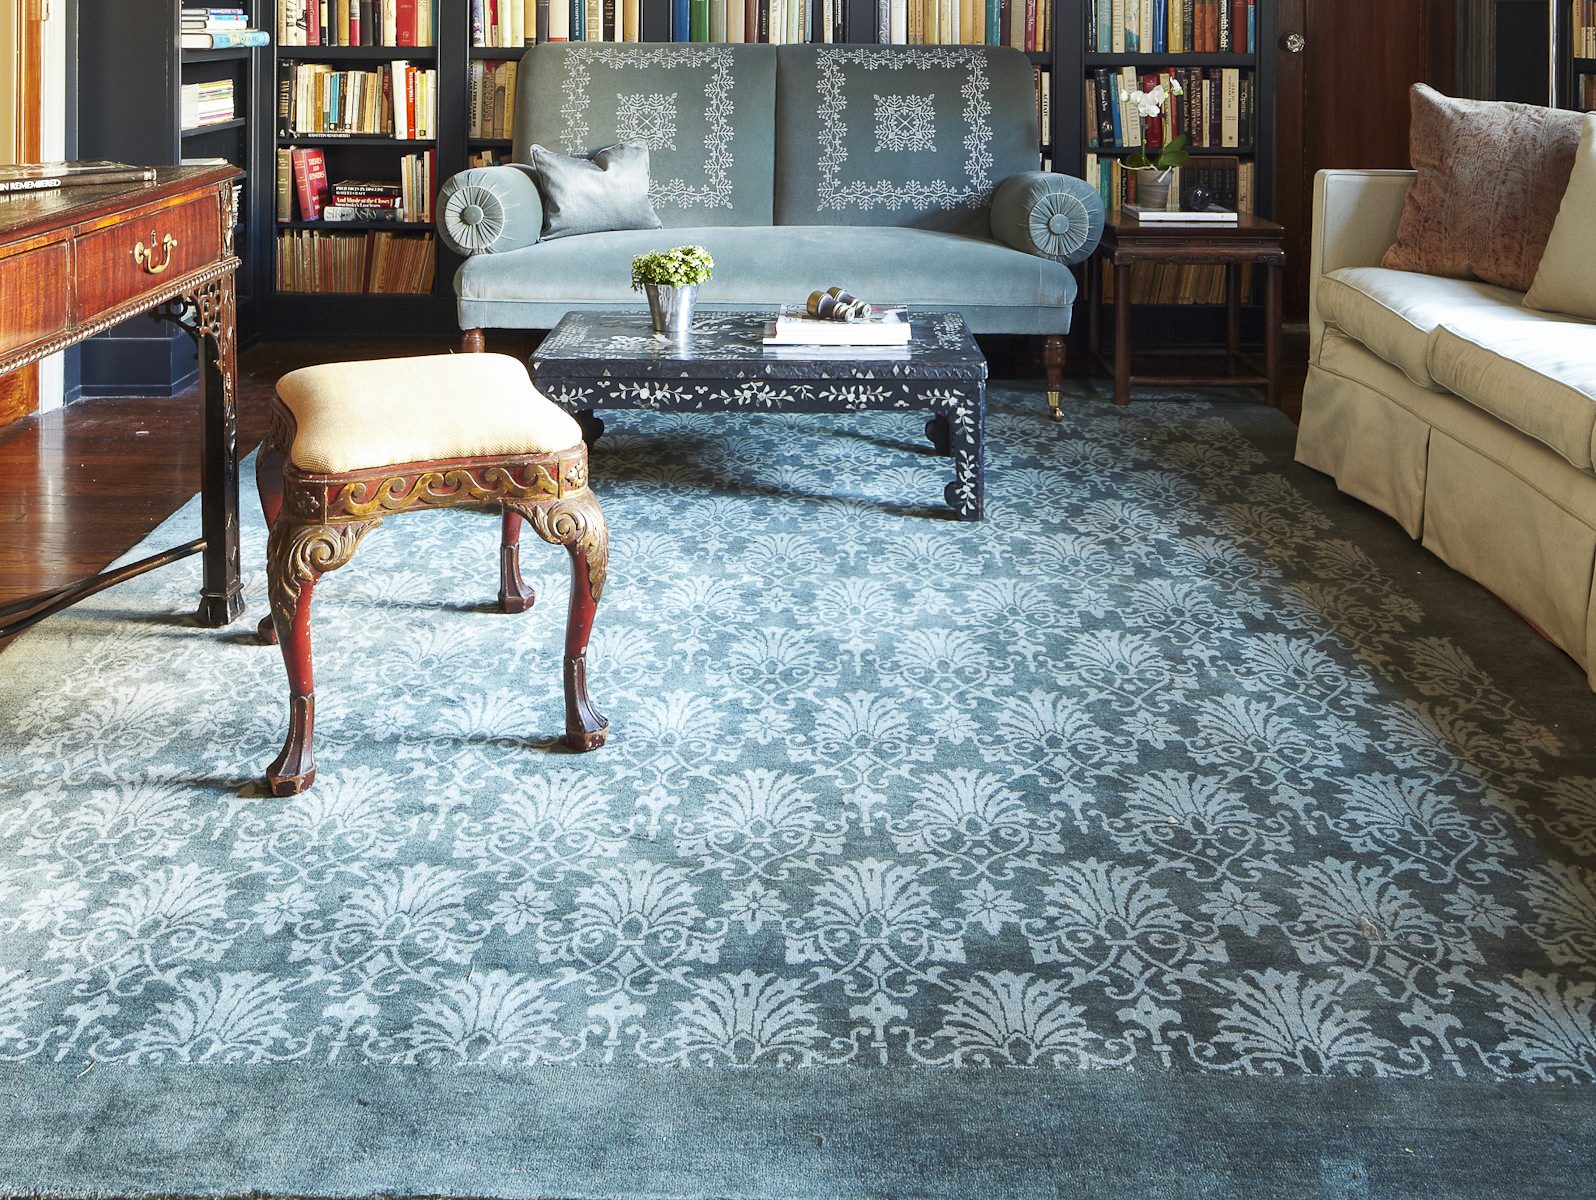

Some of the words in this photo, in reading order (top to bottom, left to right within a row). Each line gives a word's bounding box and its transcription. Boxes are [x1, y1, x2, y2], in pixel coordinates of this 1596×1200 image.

[1221, 13, 1229, 29] with
[1221, 29, 1229, 48] Solti
[1240, 92, 1248, 113] Opera
